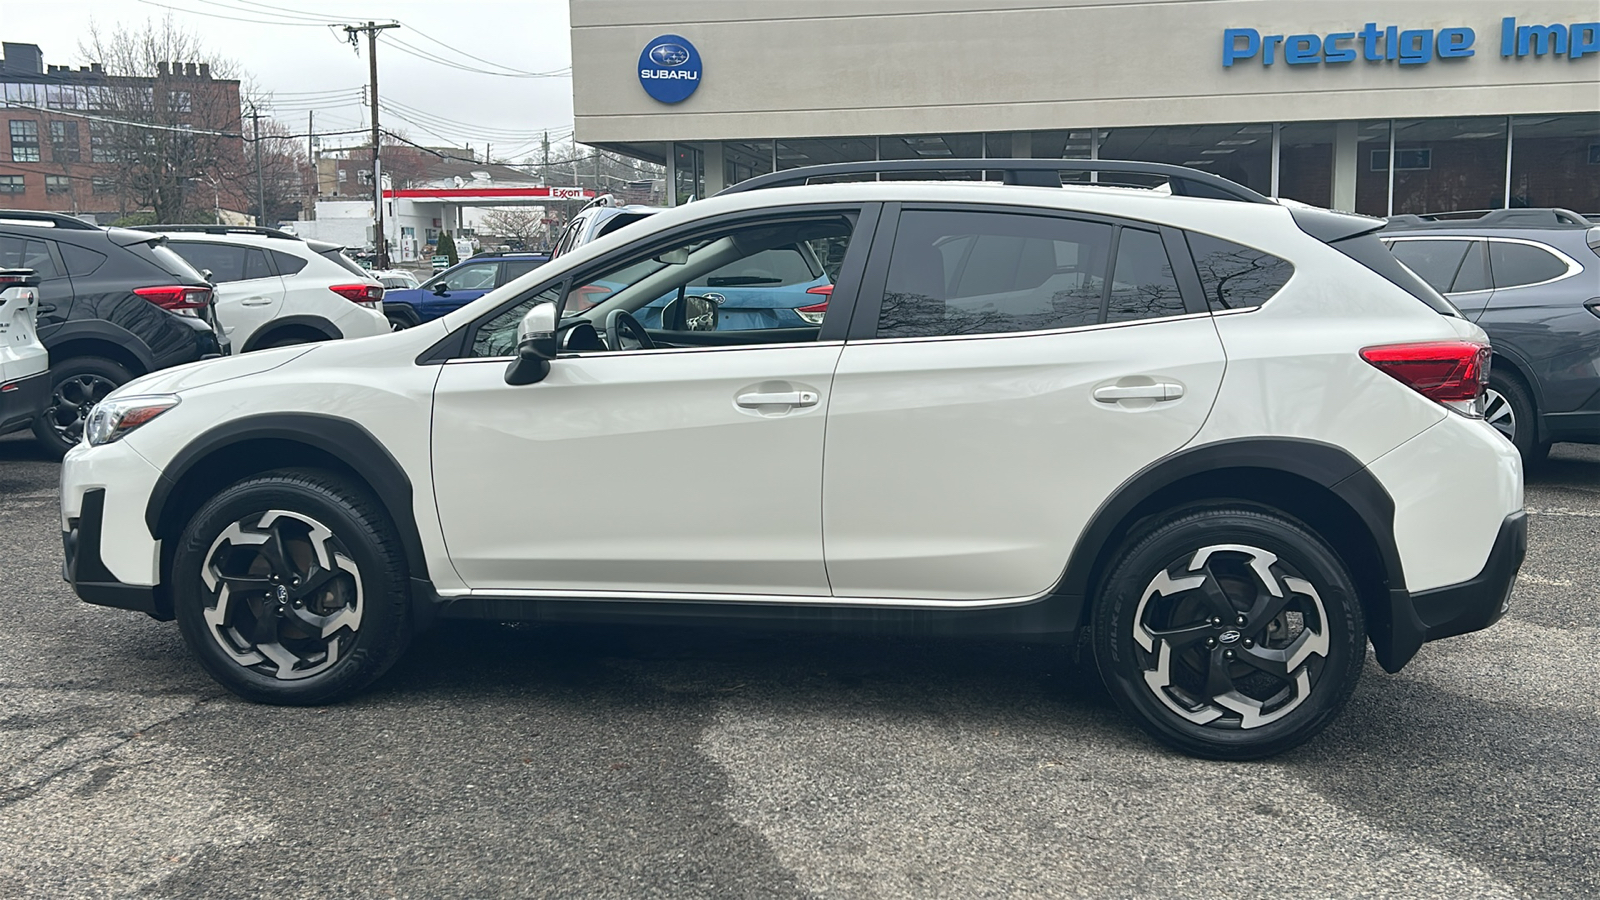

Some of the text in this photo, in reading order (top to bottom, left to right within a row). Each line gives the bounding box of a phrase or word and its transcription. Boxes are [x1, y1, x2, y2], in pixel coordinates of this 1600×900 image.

[1222, 17, 1600, 67] Prestige Imp
[641, 69, 698, 80] SUBARU
[552, 188, 580, 199] Exxon
